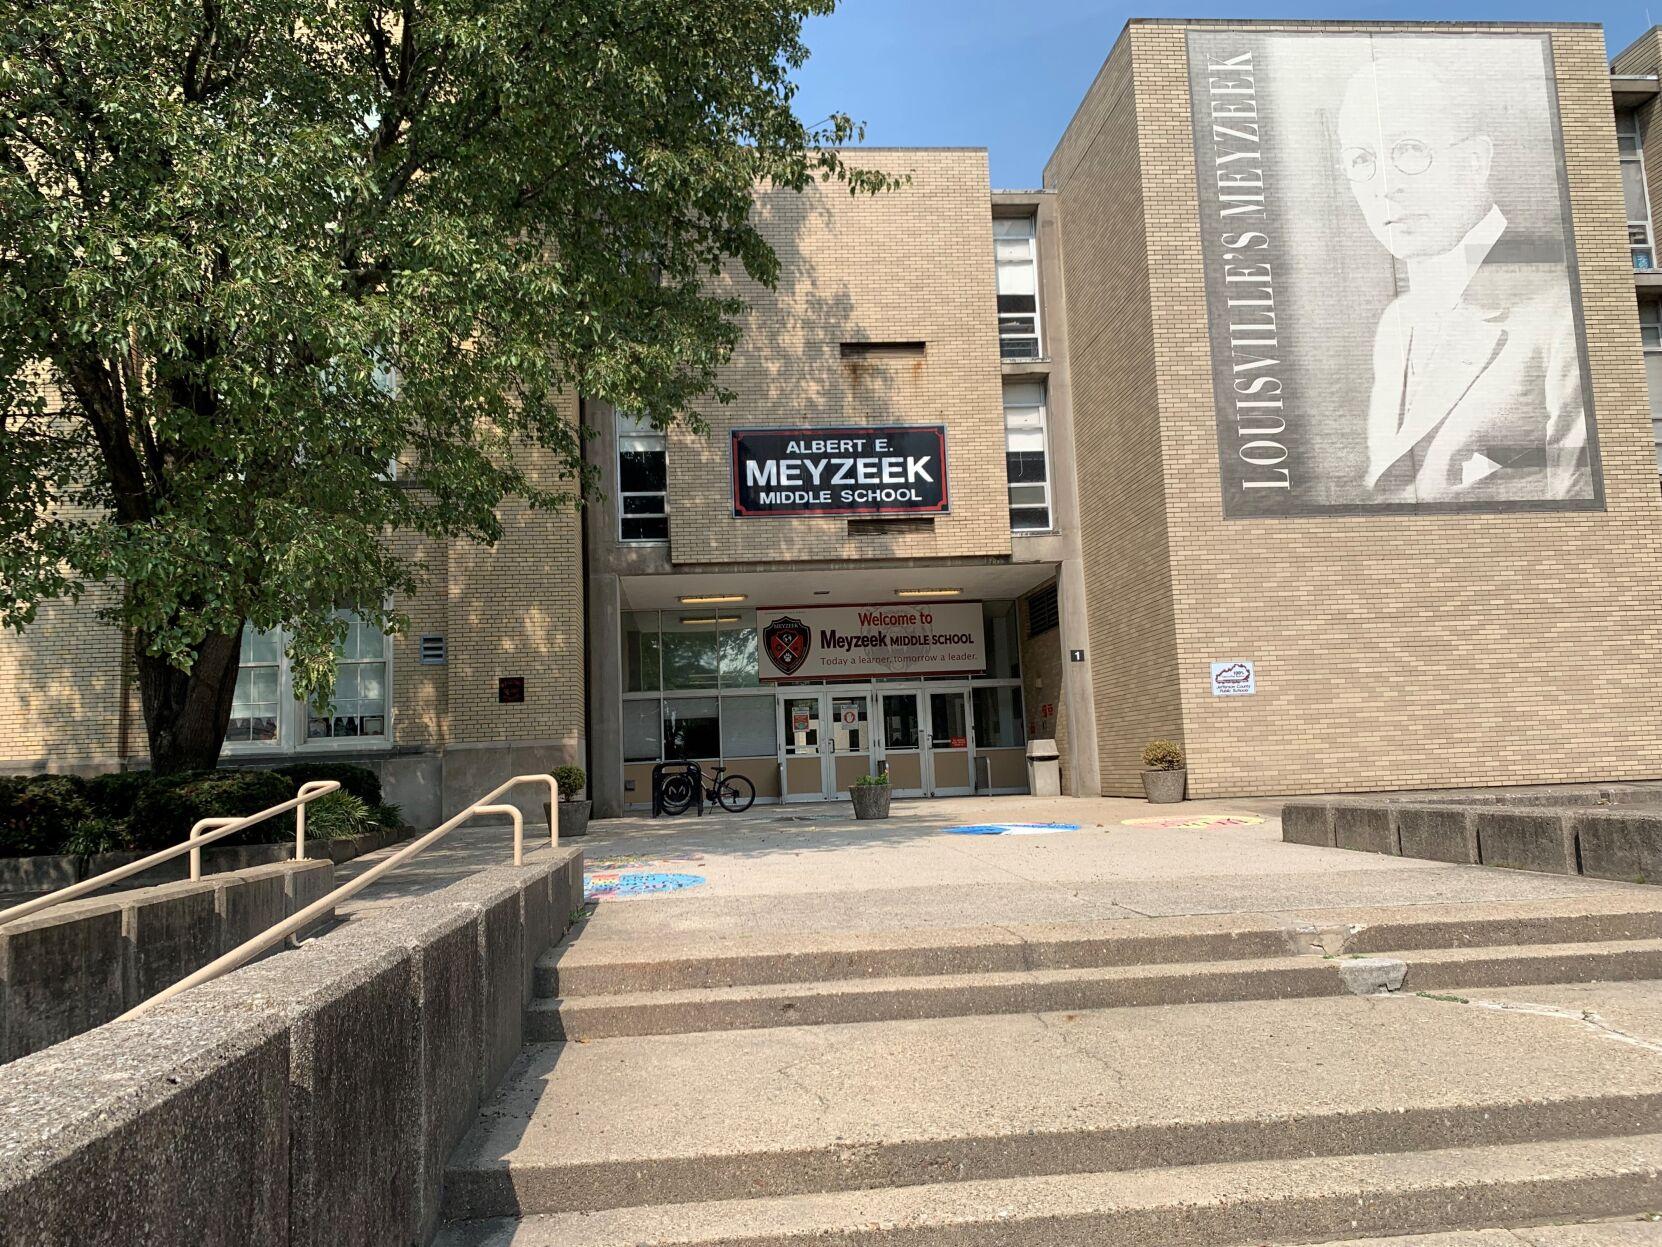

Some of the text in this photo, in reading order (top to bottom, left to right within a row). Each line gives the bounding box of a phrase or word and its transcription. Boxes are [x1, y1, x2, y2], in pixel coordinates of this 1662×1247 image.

[1207, 50, 1266, 219] MEYZEEK
[786, 439, 894, 454] ALBERT E.
[746, 456, 934, 487] MEYZEEK
[759, 488, 923, 505] MIDDLE SCHOOL
[858, 611, 933, 627] Welcome to
[820, 629, 975, 652] Meyzeek MIDDLE SCHOOL
[820, 657, 848, 666] Today
[859, 656, 892, 664] learner,
[894, 655, 938, 663] tomorrow
[948, 652, 978, 661] leader.
[1074, 651, 1080, 660] 1
